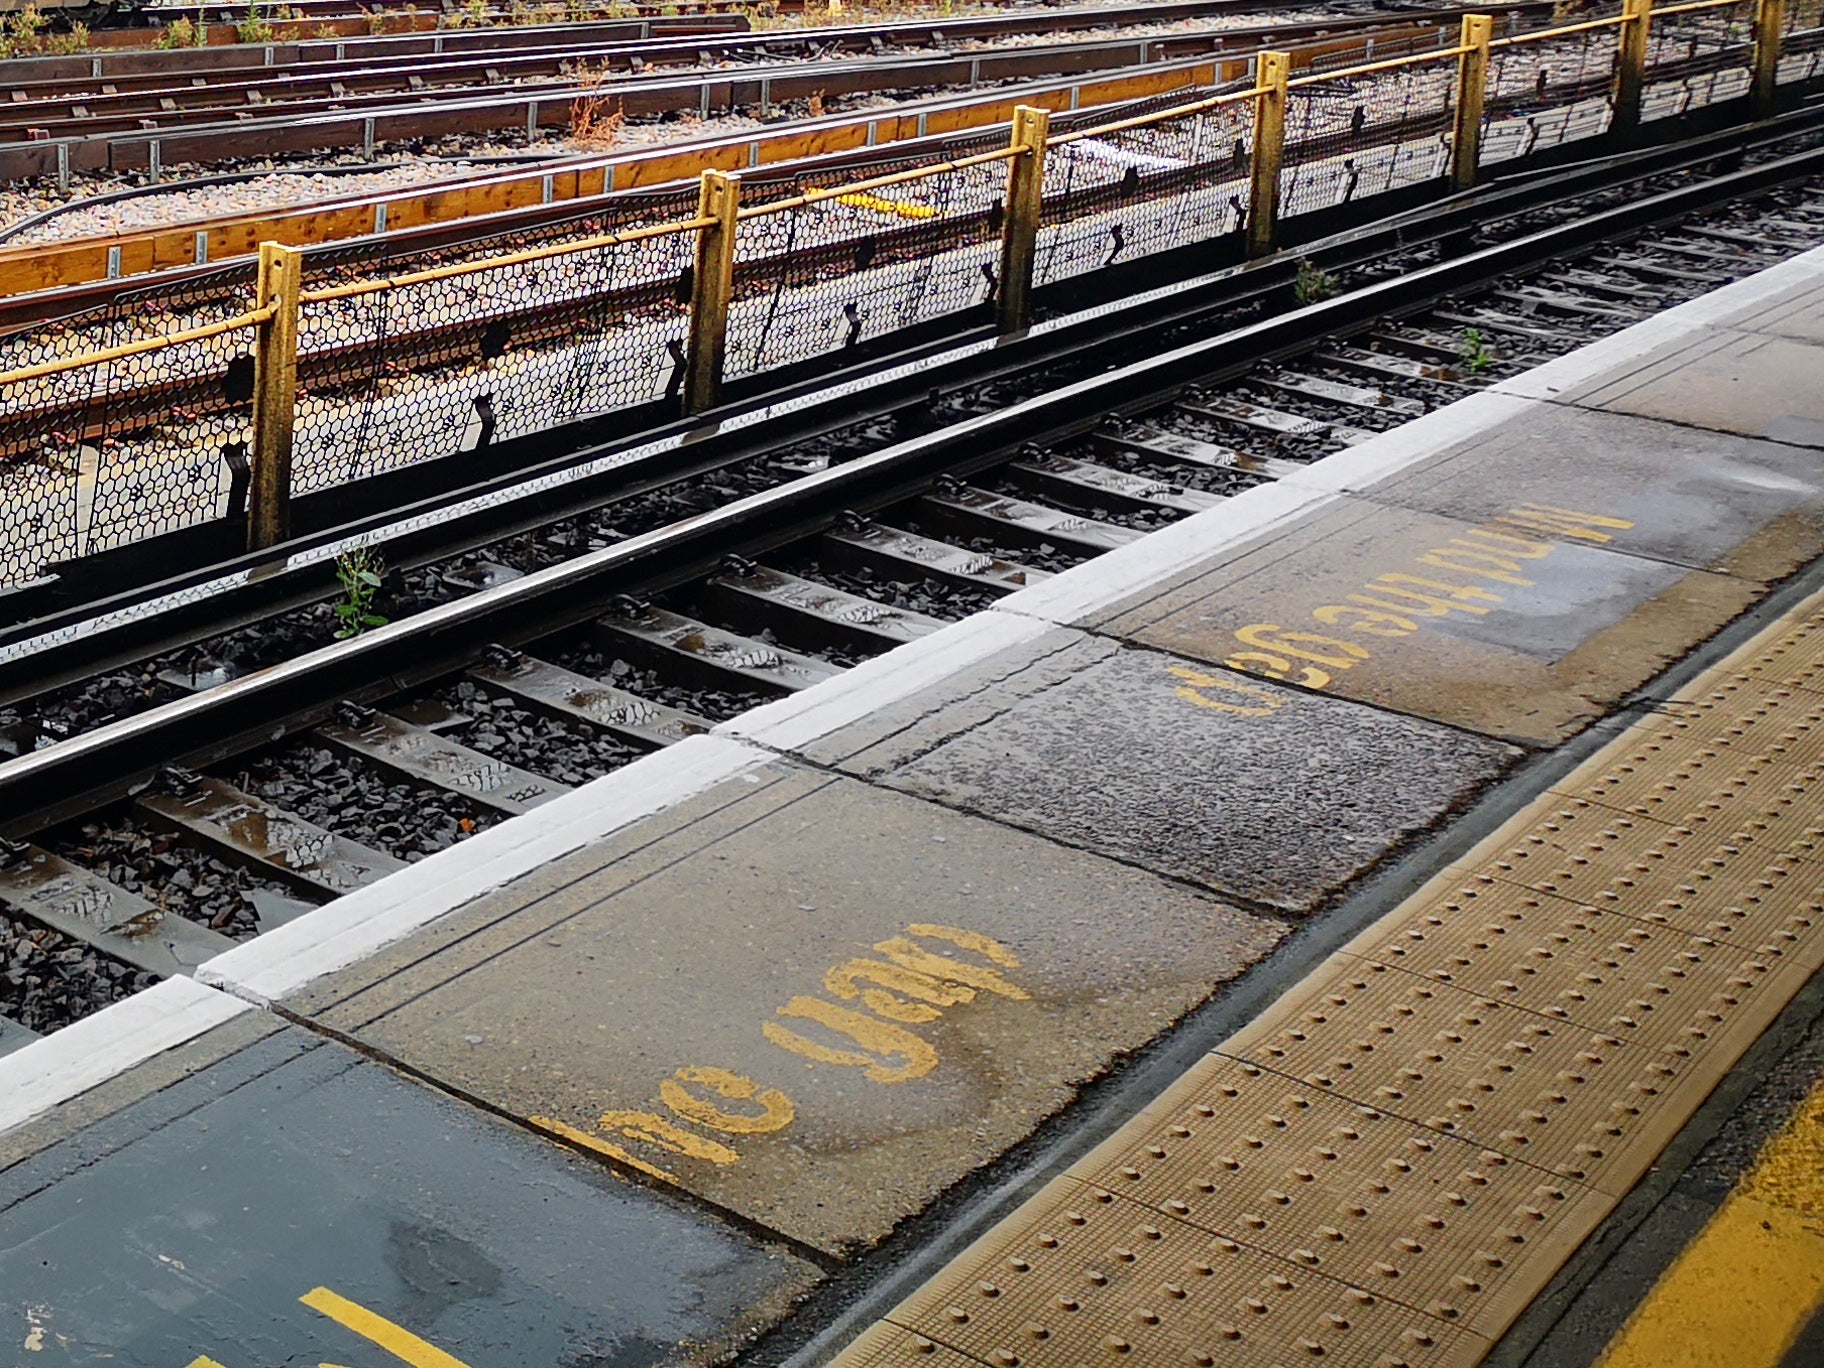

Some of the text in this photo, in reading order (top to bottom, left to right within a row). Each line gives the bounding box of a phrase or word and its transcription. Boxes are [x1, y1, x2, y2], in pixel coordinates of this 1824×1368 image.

[1312, 572, 1506, 638] the
[1167, 623, 1372, 717] gap
[761, 922, 1033, 1085] gap
